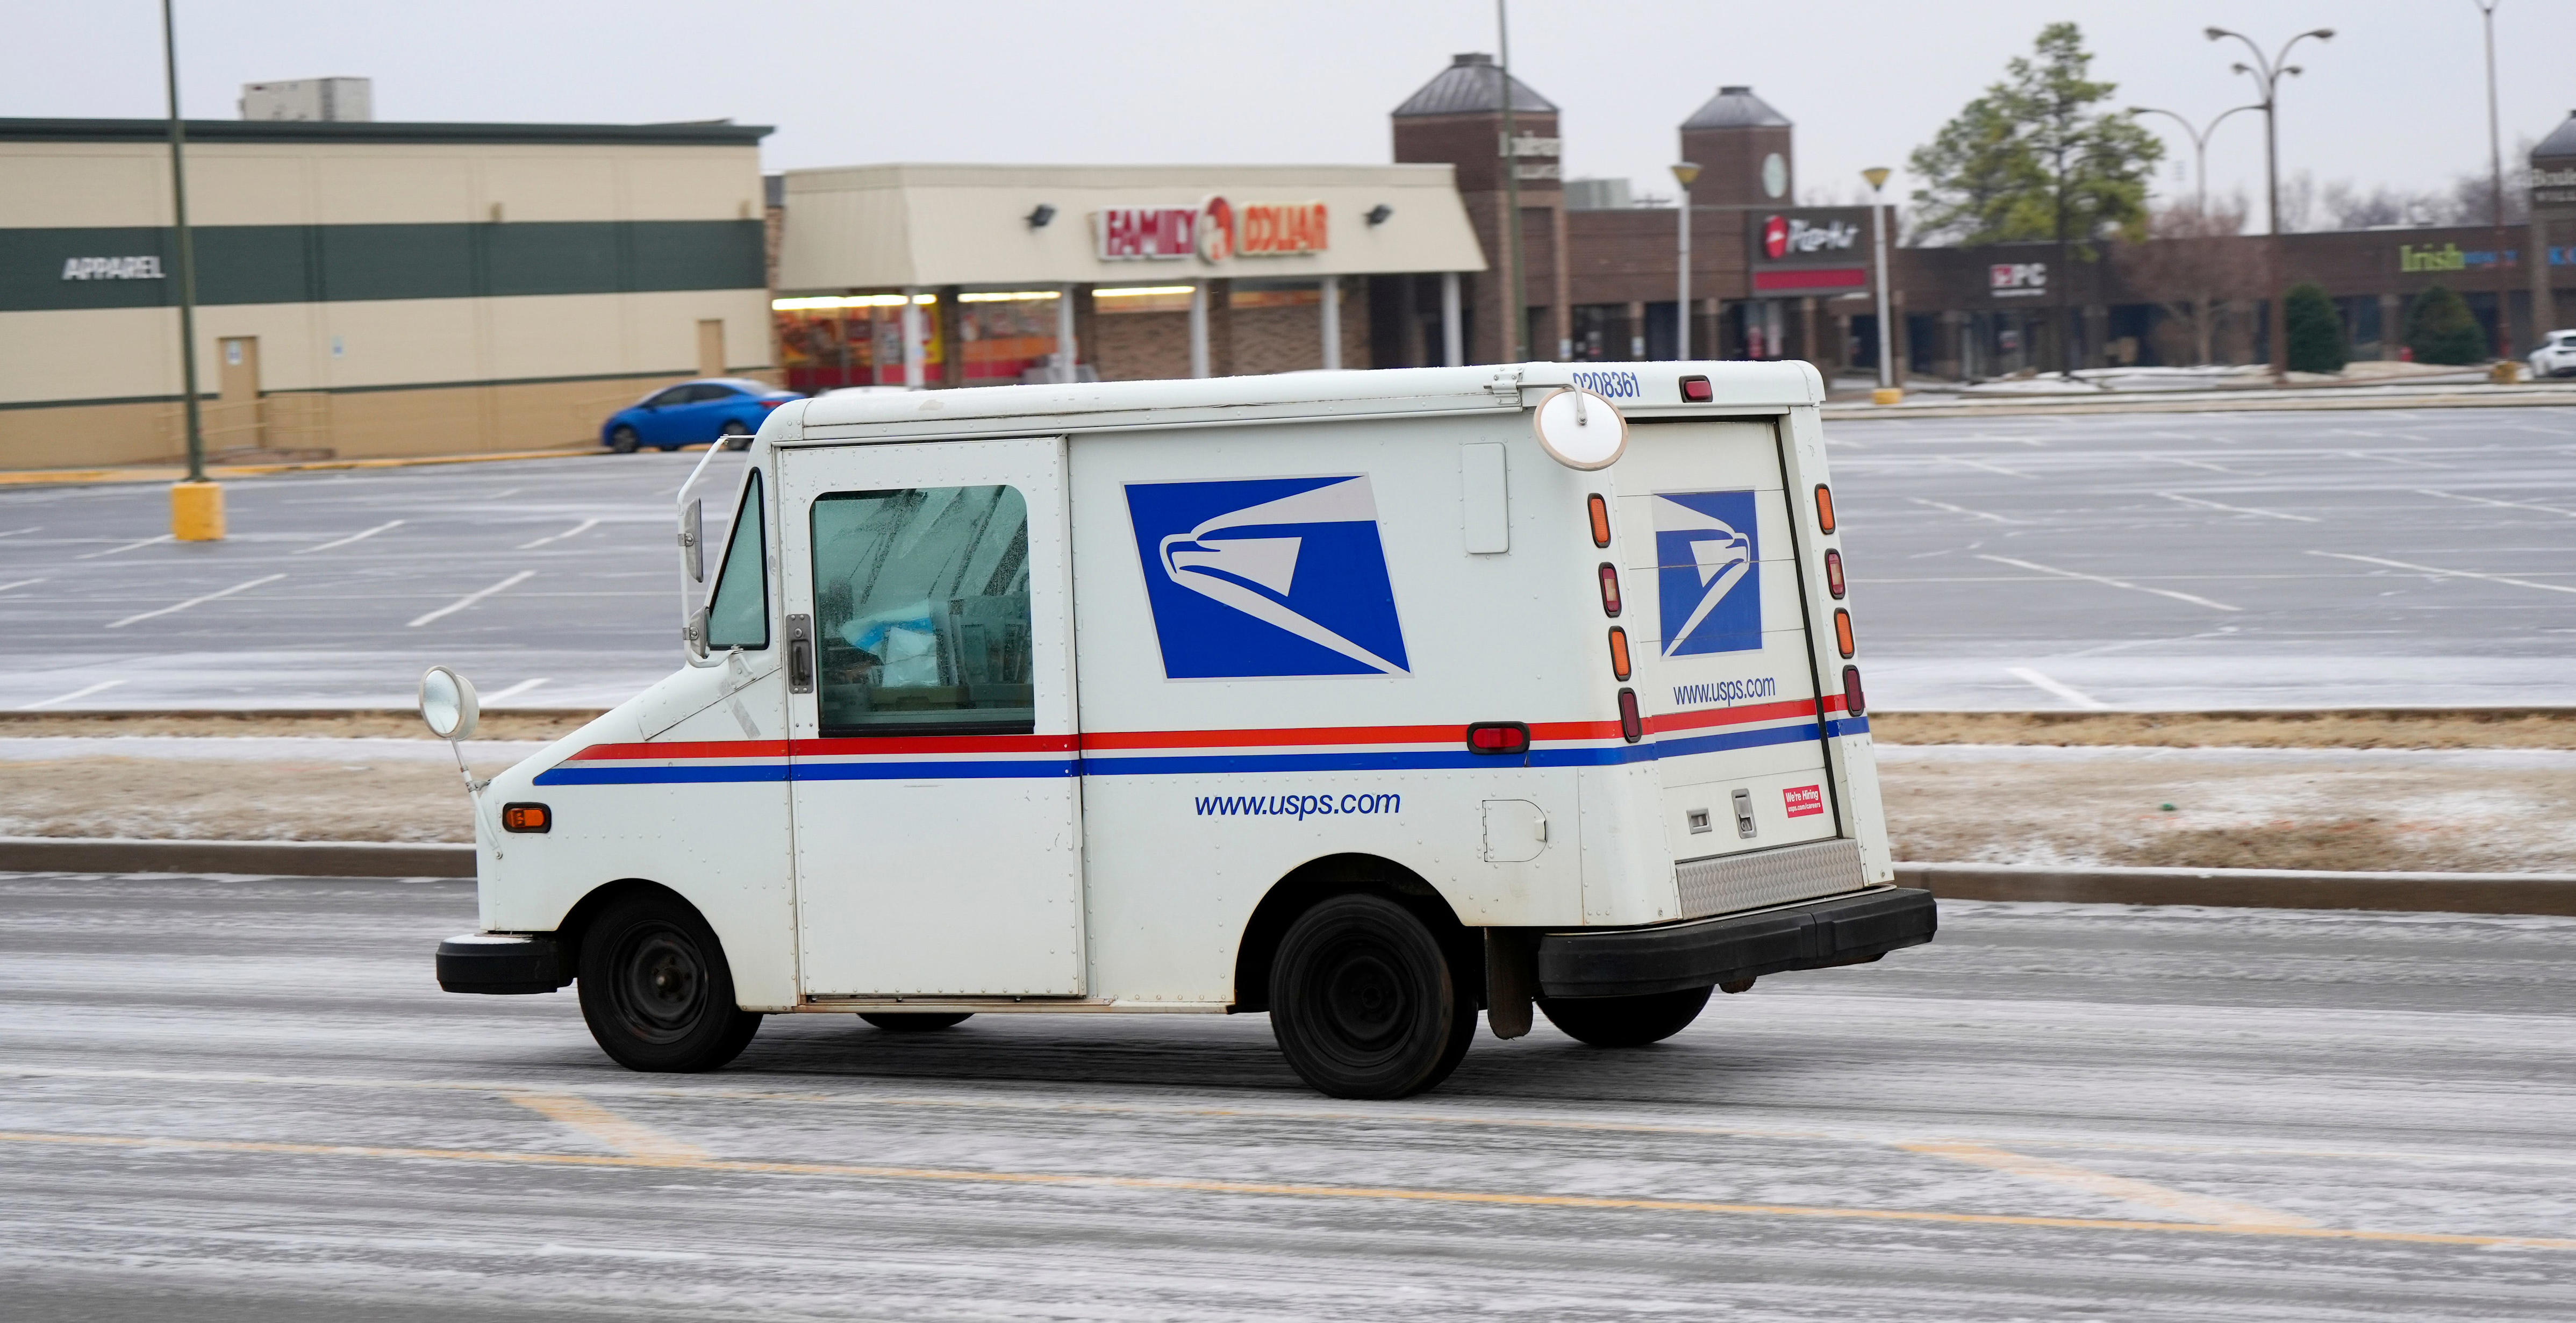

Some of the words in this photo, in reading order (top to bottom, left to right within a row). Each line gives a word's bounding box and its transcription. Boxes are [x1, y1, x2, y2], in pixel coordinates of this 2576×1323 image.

[1107, 209, 1198, 256] FAMILY
[1243, 203, 1328, 252] DOLLAR
[61, 255, 167, 281] APPAREL
[1673, 677, 1776, 707] www.usps.com
[1194, 793, 1401, 821] www.usps.com
[1785, 791, 1802, 803] We're
[1802, 789, 1819, 800] Hiring
[1787, 802, 1821, 812] usps.com/careers
